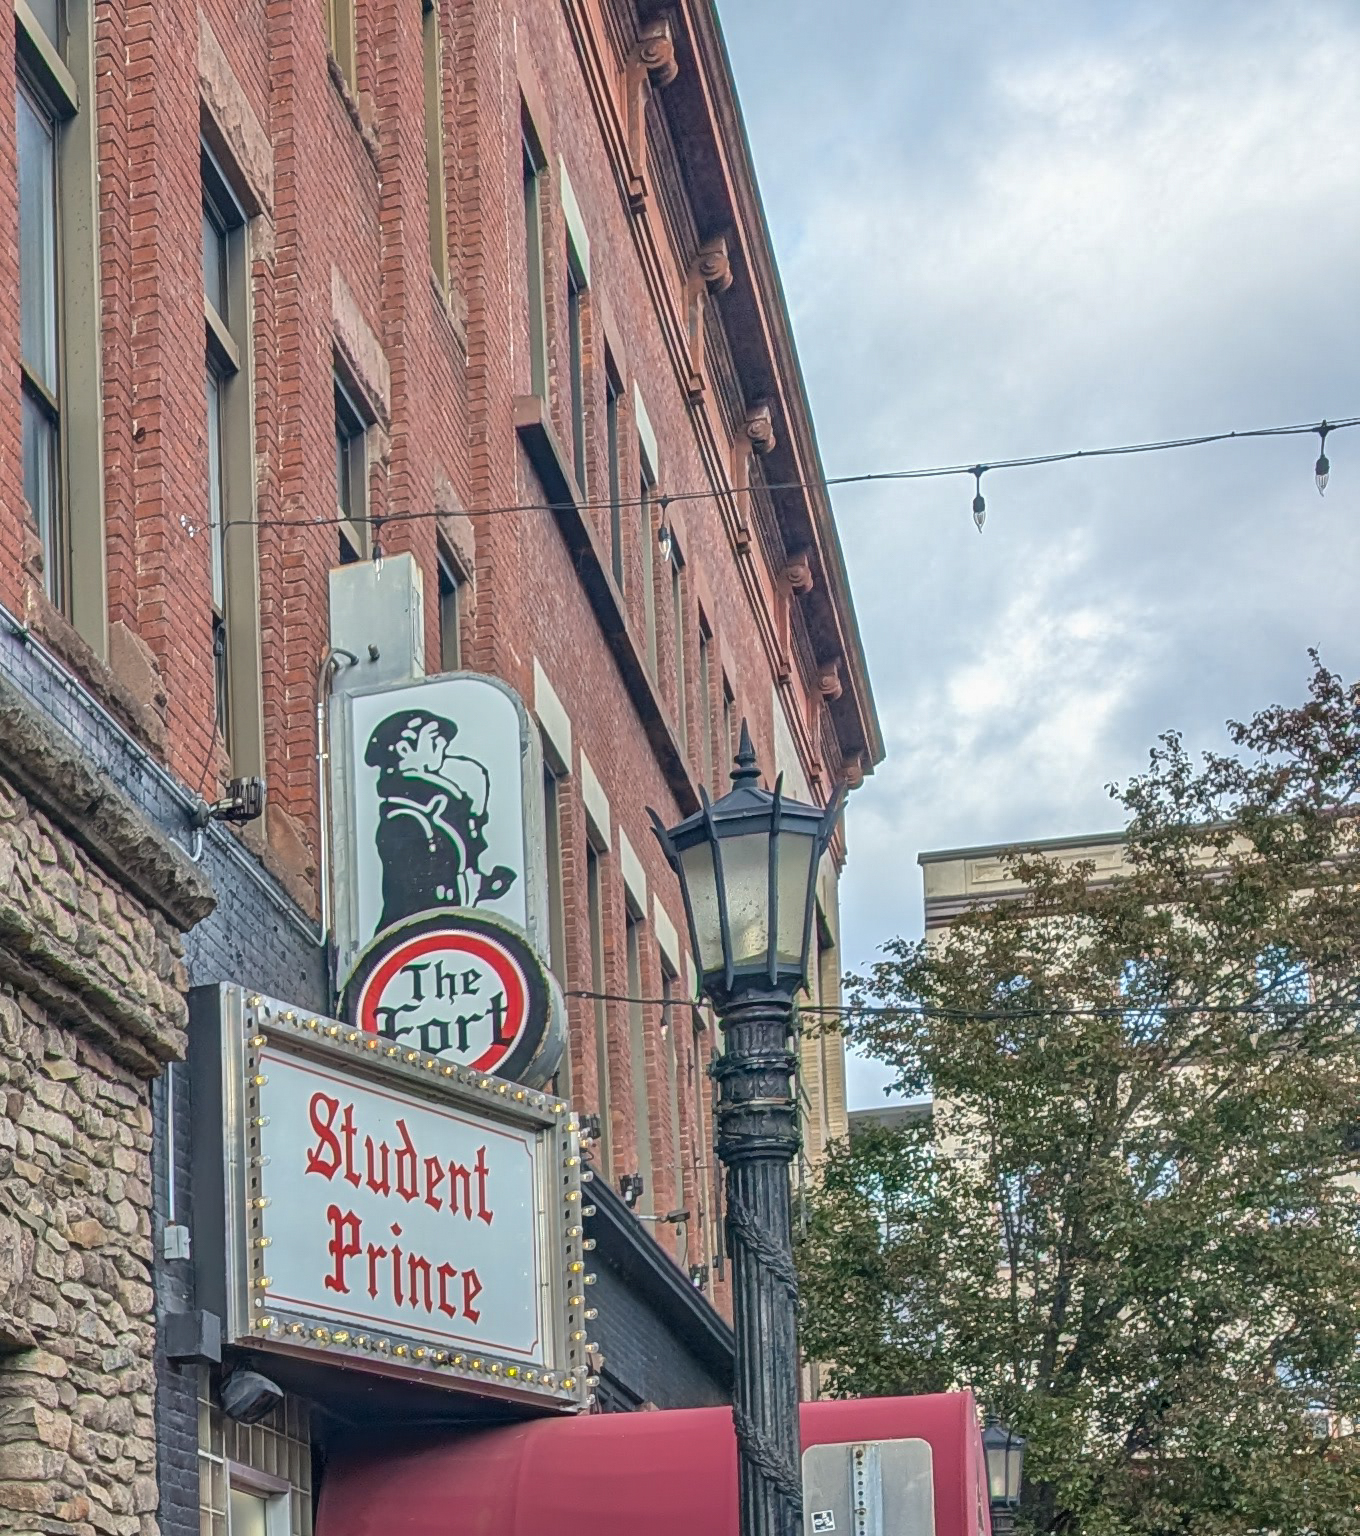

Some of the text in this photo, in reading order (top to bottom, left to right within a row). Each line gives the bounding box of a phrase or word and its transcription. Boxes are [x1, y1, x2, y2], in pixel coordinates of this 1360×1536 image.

[372, 991, 516, 1055] Fort
[399, 959, 484, 1005] The
[304, 1091, 495, 1226] Student
[323, 1203, 484, 1325] Prince
